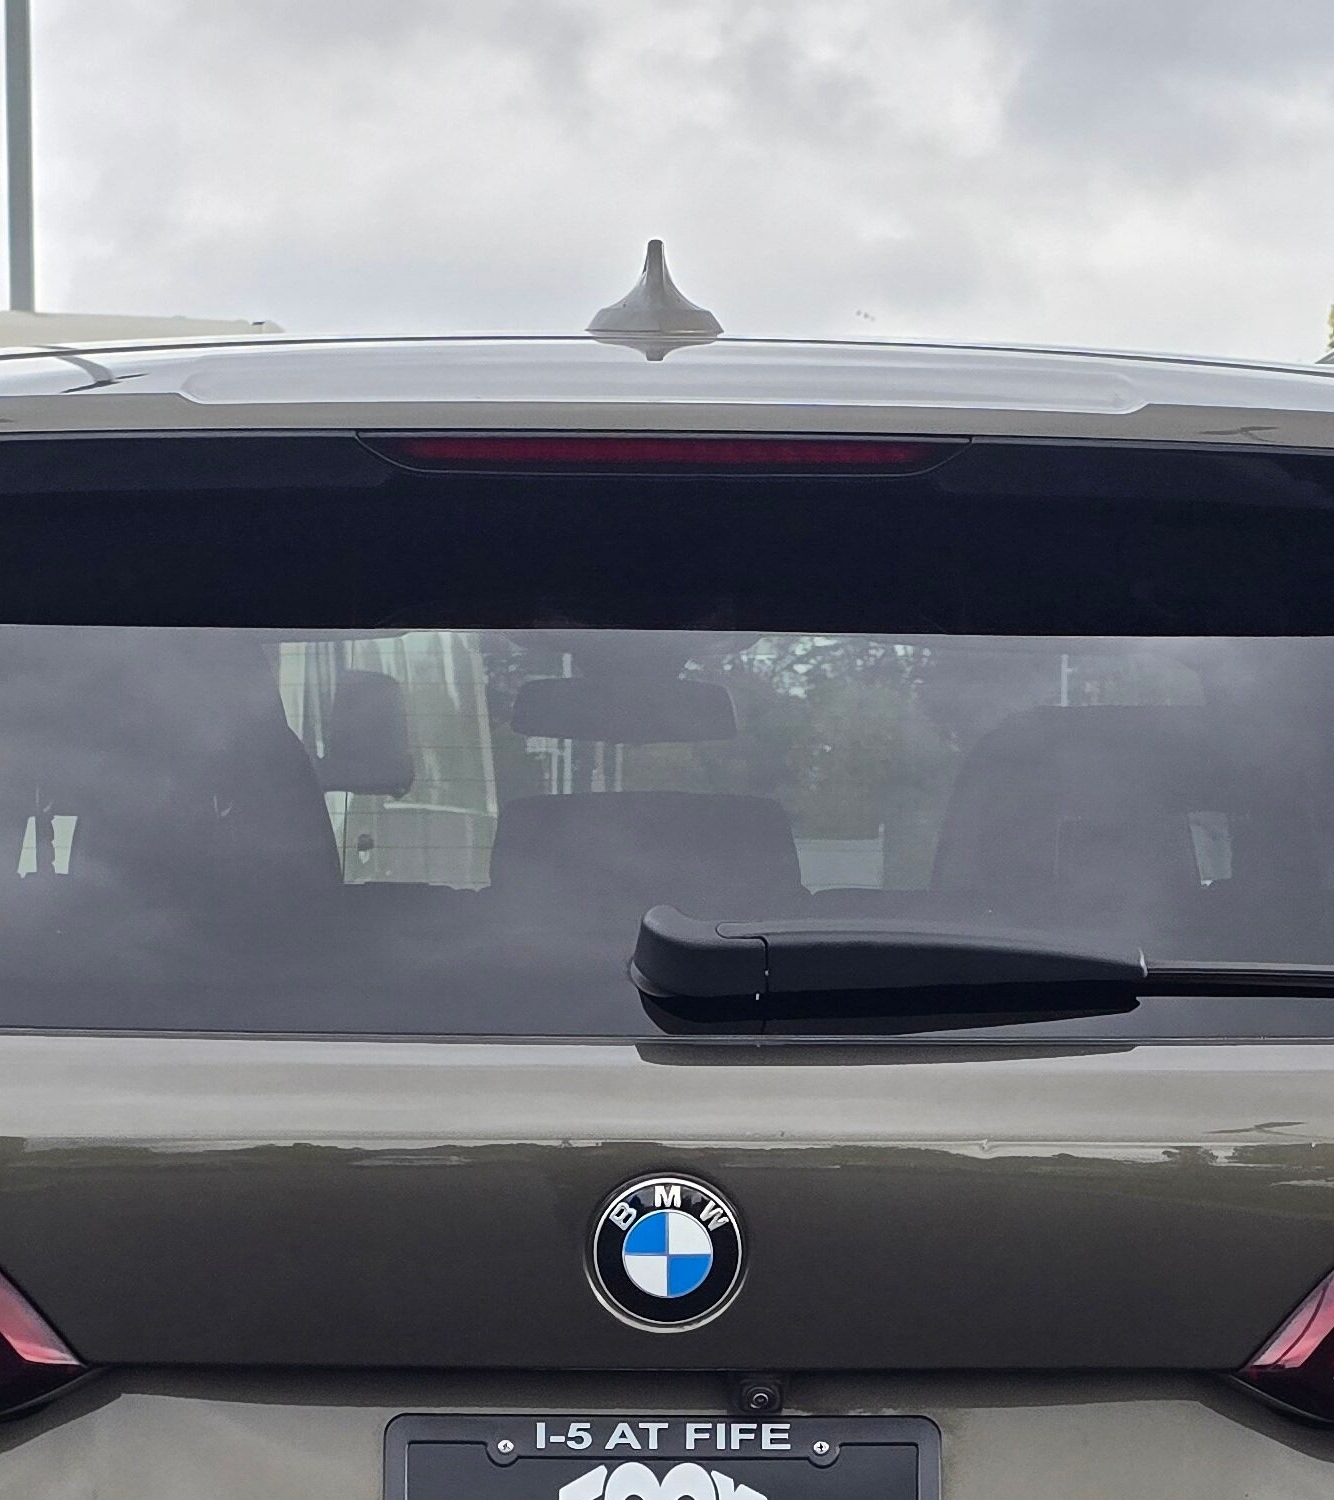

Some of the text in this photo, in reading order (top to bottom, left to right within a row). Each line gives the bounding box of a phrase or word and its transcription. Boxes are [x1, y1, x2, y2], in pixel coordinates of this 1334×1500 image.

[608, 1184, 730, 1232] BMW
[534, 1422, 792, 1450] I-5 AT FIFE
